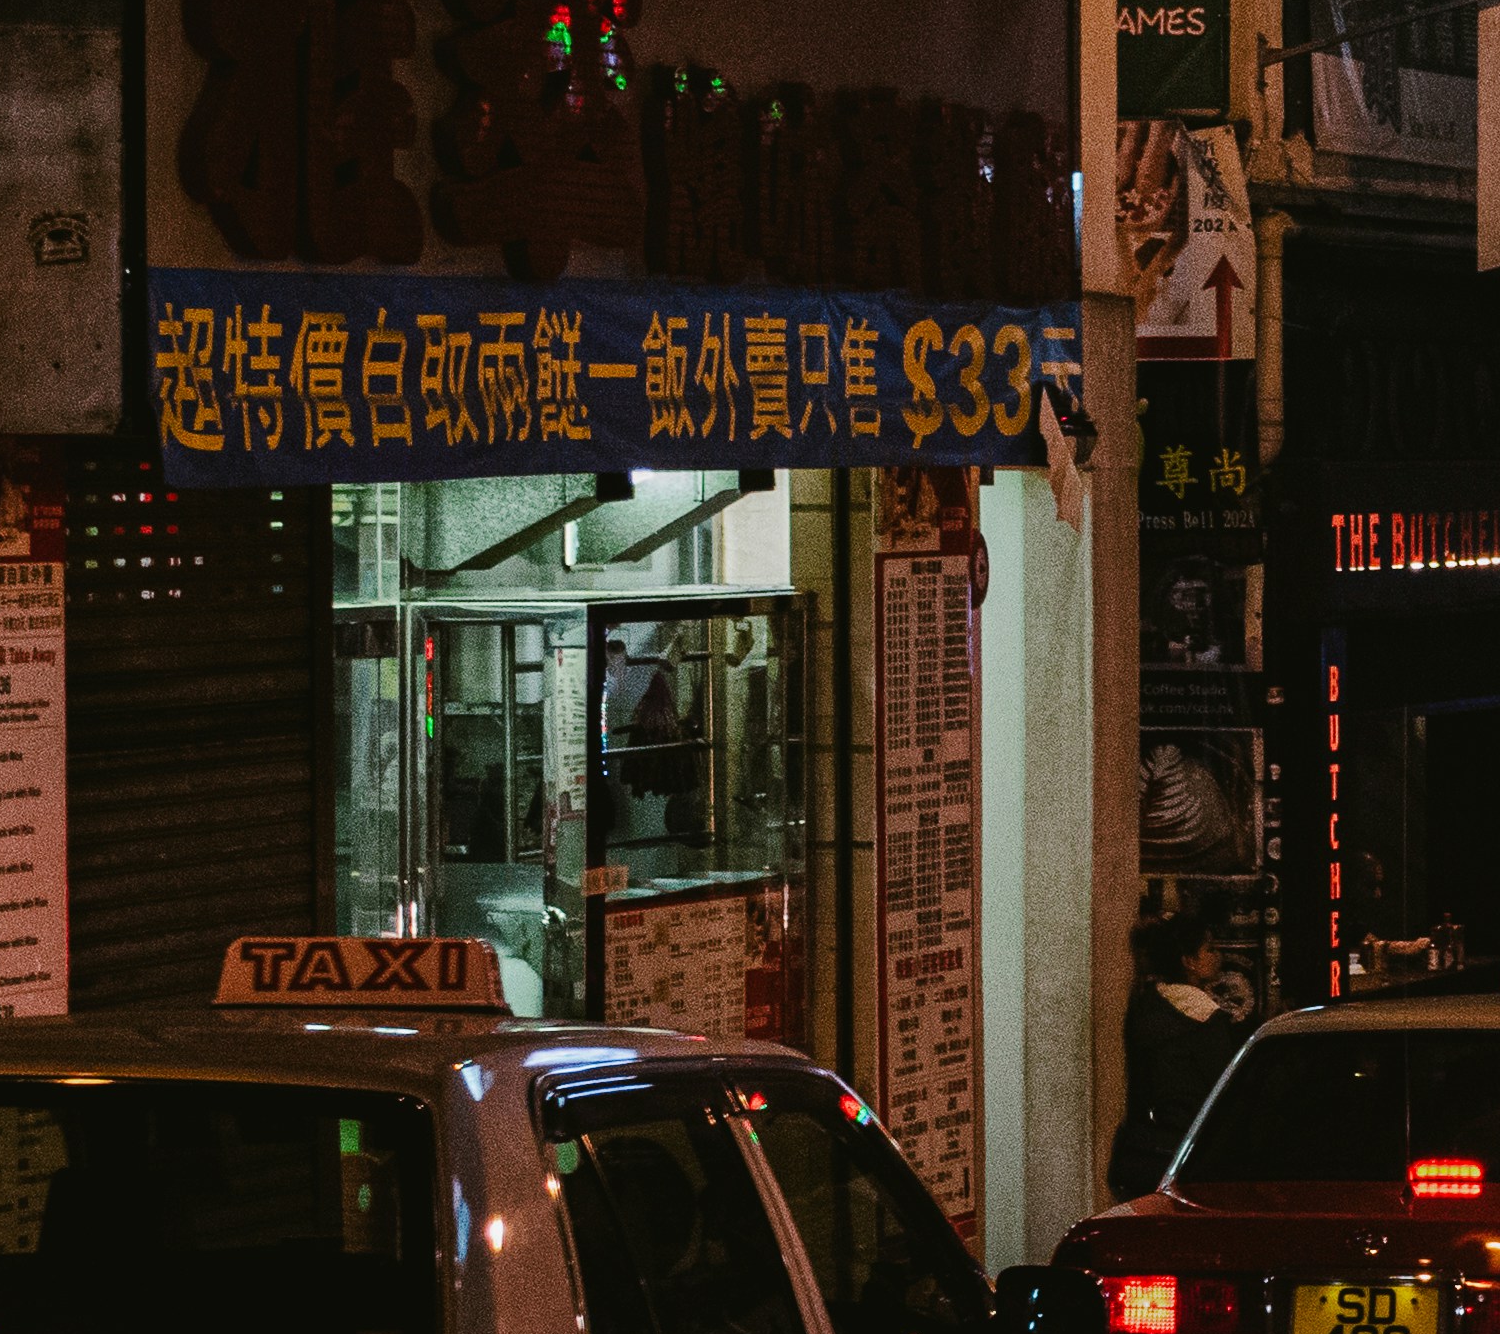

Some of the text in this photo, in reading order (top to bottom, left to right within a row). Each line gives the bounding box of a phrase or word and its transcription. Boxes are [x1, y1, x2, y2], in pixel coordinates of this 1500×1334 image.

[1183, 508, 1217, 531] Bell
[1331, 512, 1381, 571] THE
[1143, 683, 1185, 696] Coffee
[241, 941, 468, 991] TAXI
[1336, 1287, 1397, 1325] SD
